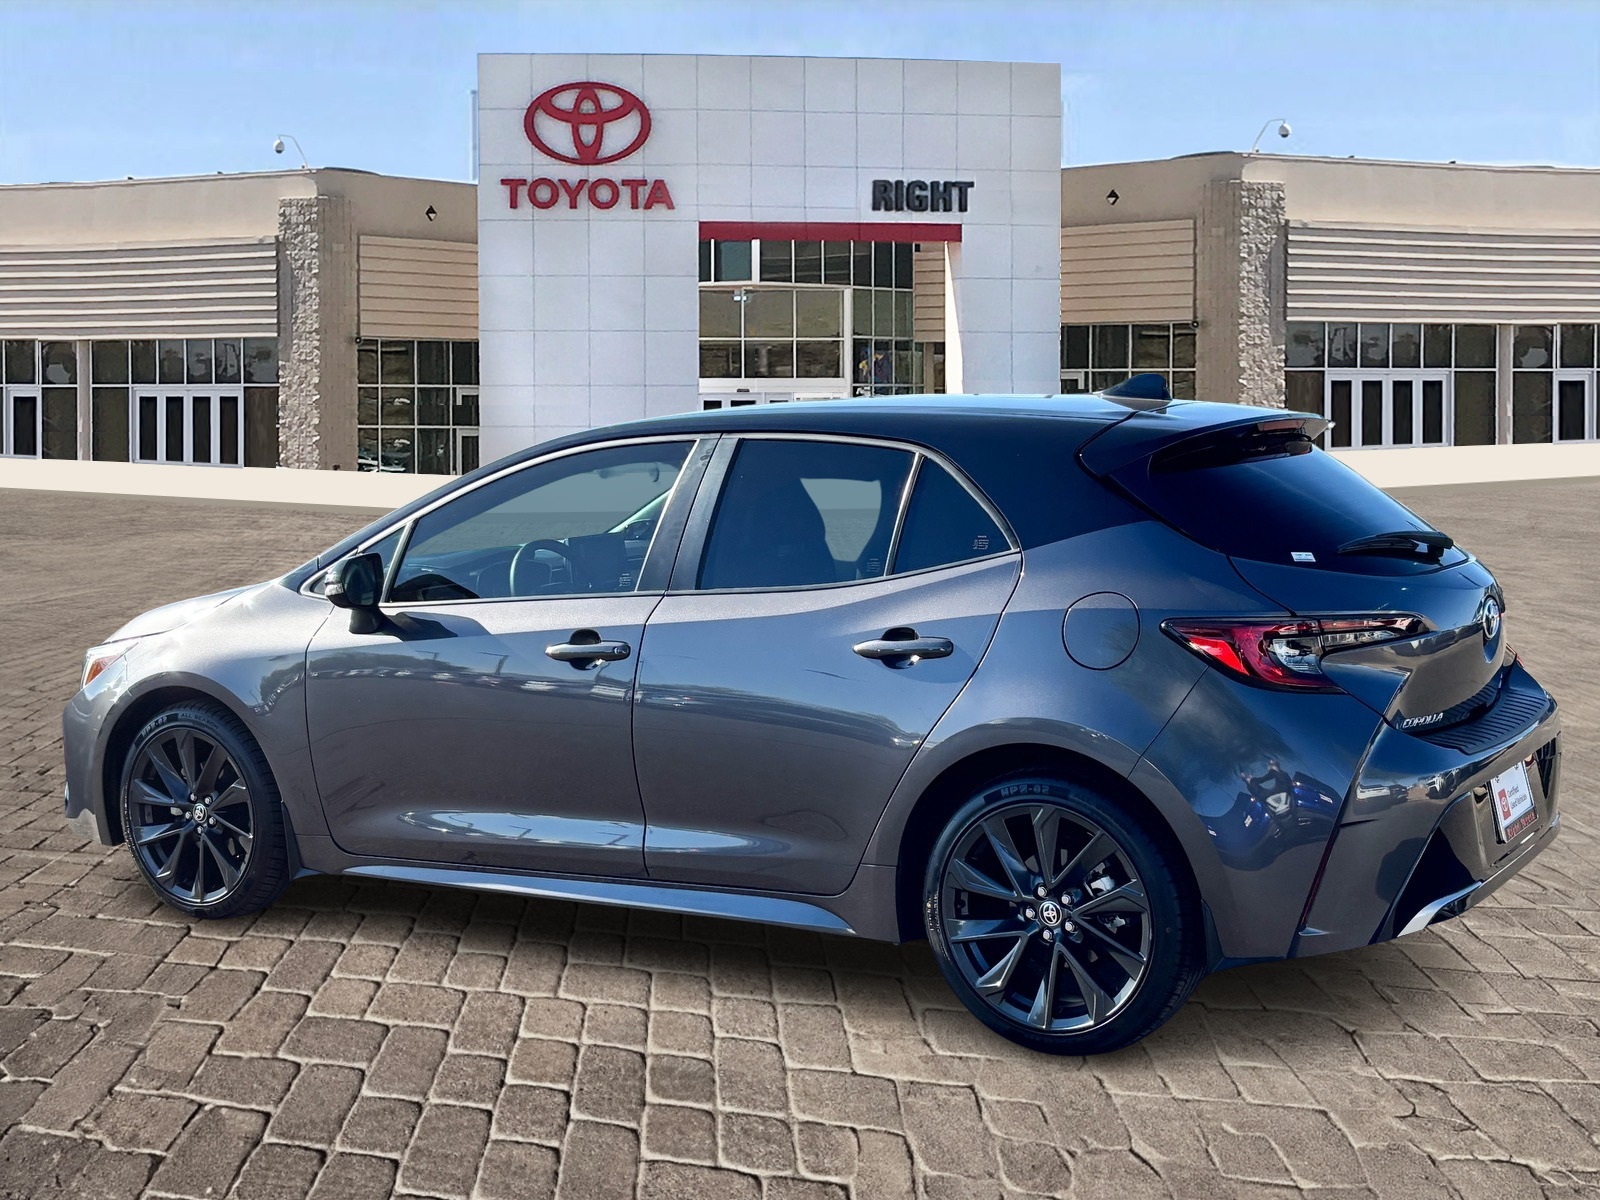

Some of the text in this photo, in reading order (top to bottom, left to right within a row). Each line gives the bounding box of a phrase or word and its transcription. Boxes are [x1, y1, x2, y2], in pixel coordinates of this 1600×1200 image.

[500, 179, 675, 209] TOYOTA
[871, 179, 976, 212] RIGHT
[1403, 713, 1443, 728] COROLLA
